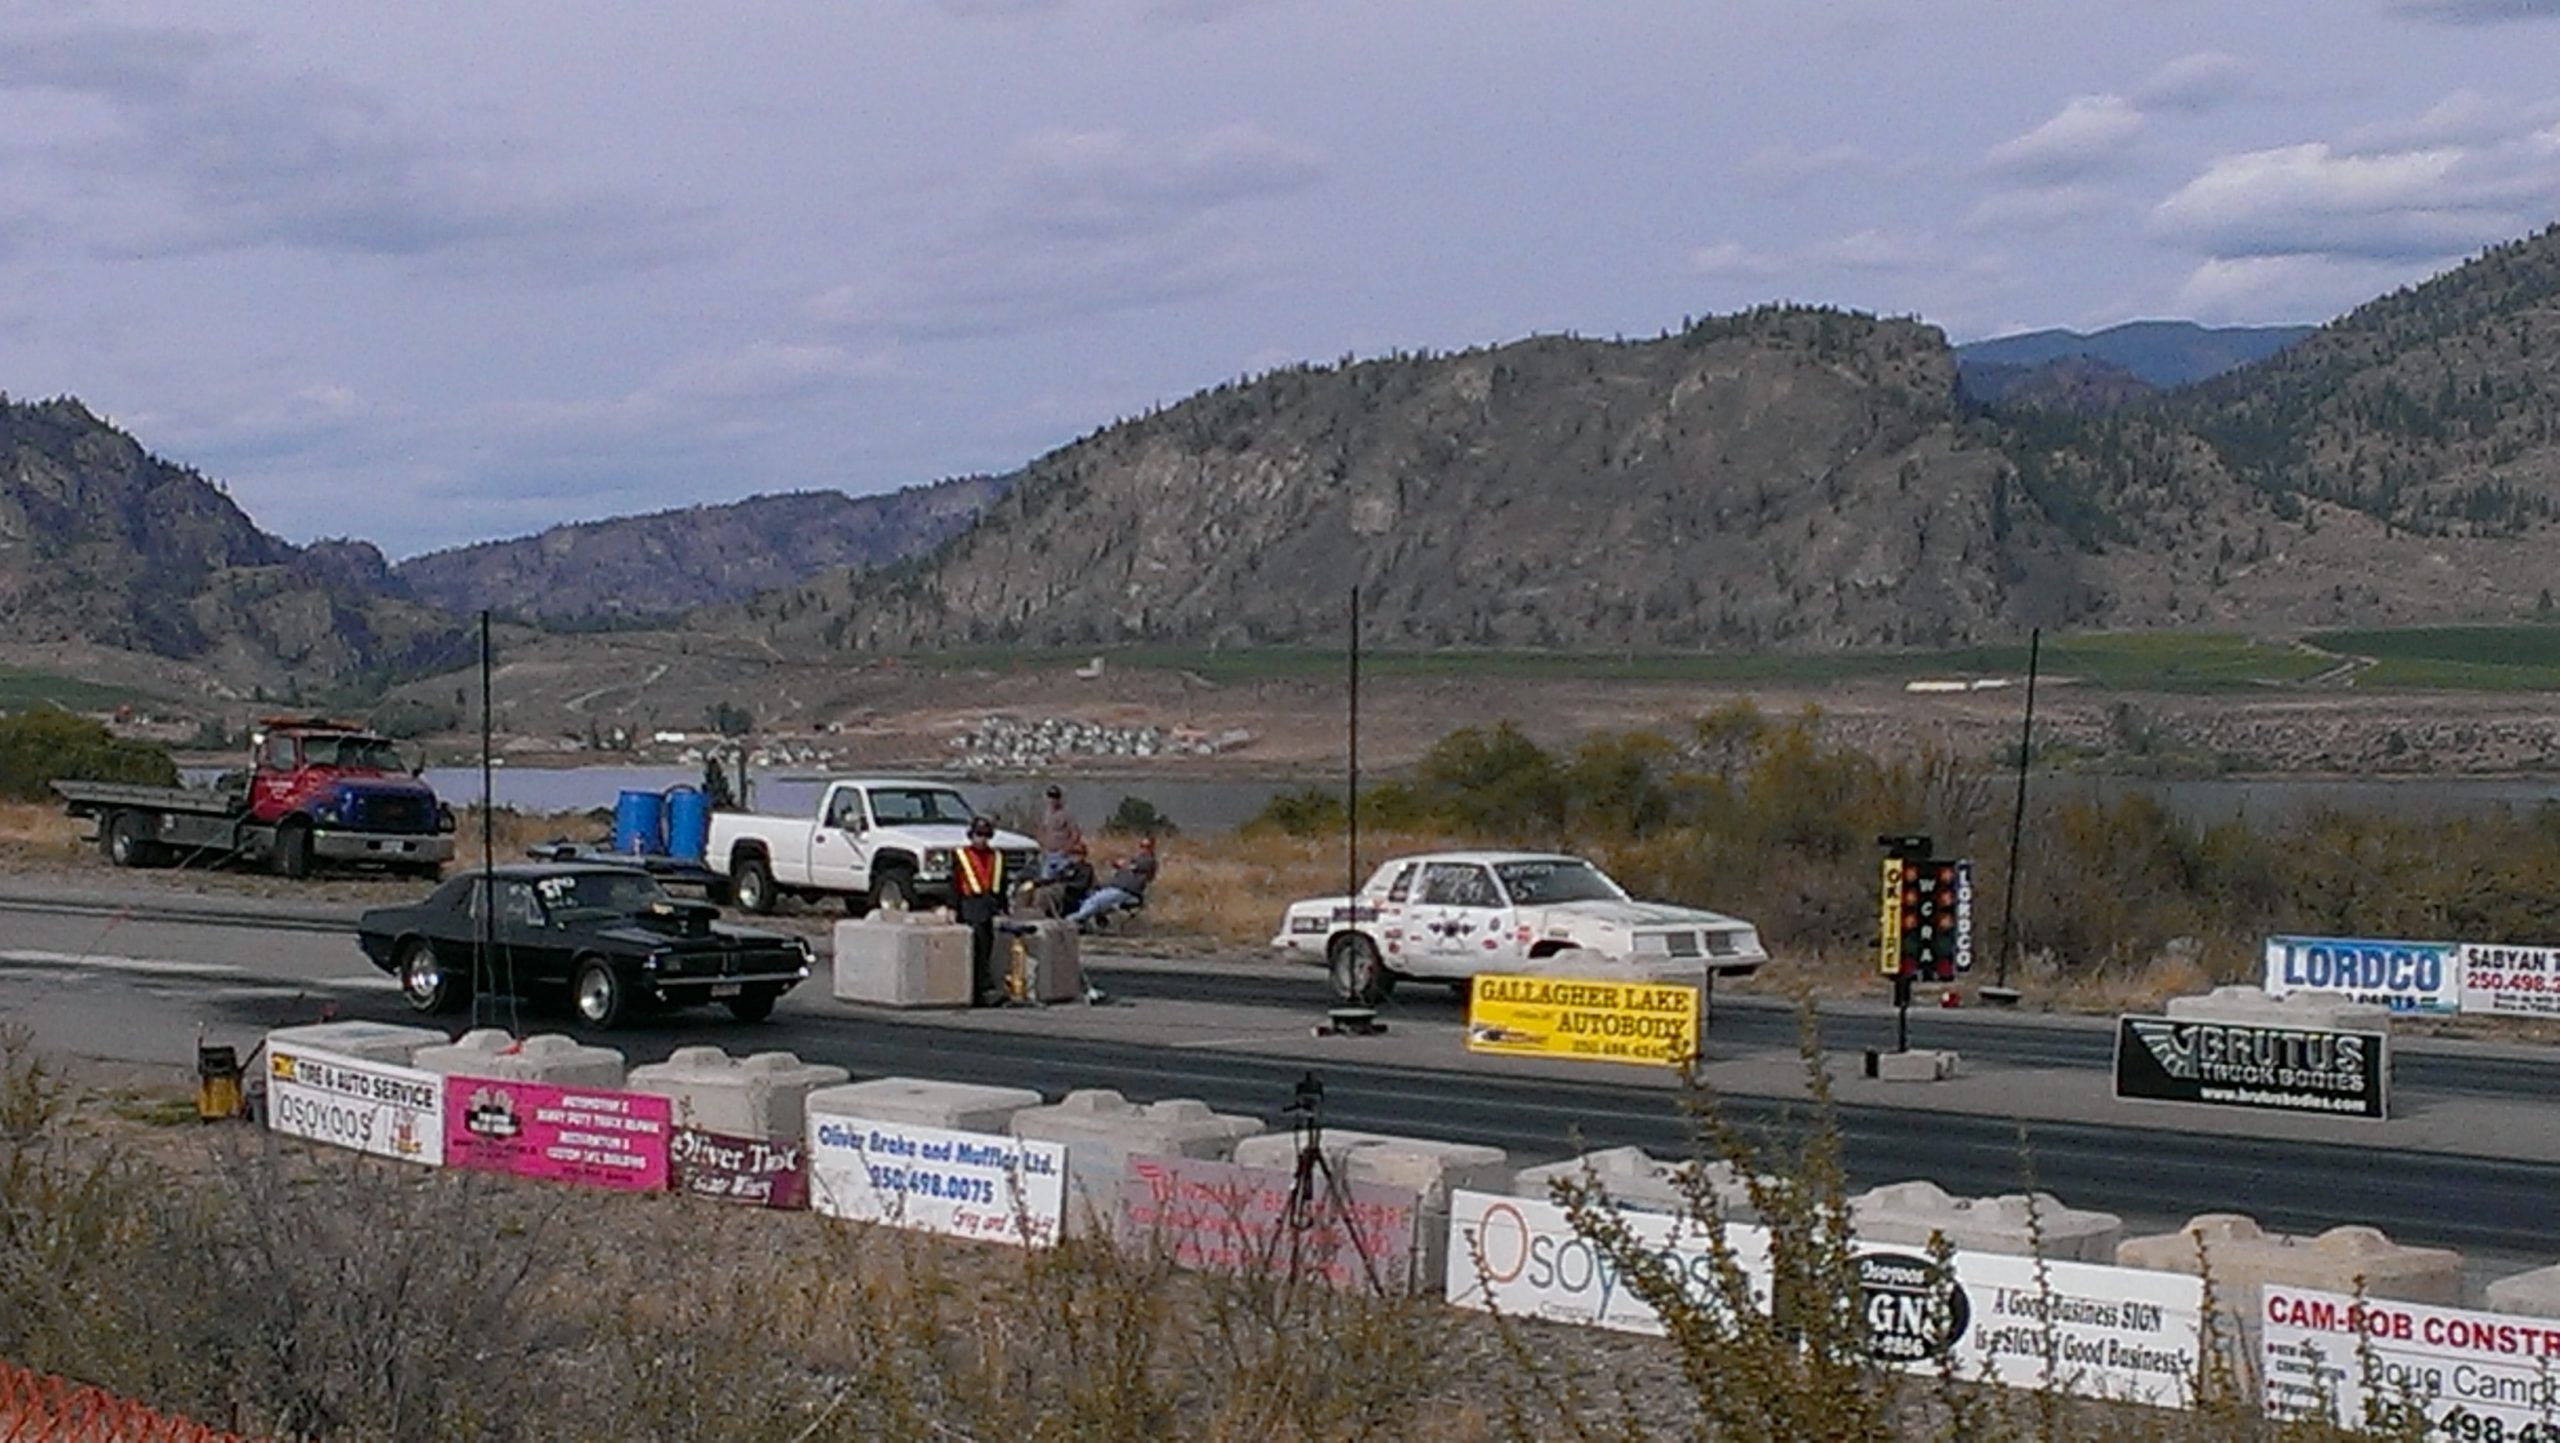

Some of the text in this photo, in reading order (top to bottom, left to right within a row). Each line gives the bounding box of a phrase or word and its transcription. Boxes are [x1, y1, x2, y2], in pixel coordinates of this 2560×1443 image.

[1919, 878, 1937, 963] WCRA
[1956, 869, 1972, 968] LORDCO
[2284, 946, 2441, 992] LORDCO
[2467, 948, 2546, 972] SABYAN
[1480, 980, 1690, 1014] GALLAGHER LAKE
[1556, 1012, 1686, 1042] AUTOBODY
[2201, 1026, 2364, 1073] BRUTUS
[300, 1061, 323, 1087] TIRE
[338, 1071, 370, 1096] AUTO
[373, 1077, 434, 1109] SERVICE
[2201, 1062, 2365, 1093] TRUCK BODIES
[2201, 1087, 2367, 1113] www.brutusbodies.com
[280, 1094, 373, 1142] OSOYOOS
[818, 1124, 1057, 1177] Oliver Brake and Muffler Ltd.
[1480, 1201, 1716, 1321] Osoyos
[1992, 1286, 2004, 1315] A
[2052, 1292, 2119, 1328] Business
[2121, 1301, 2161, 1333] SIGN
[1974, 1323, 1989, 1350] is
[2063, 1333, 2105, 1366] Good
[2365, 1353, 2443, 1398] Doug
